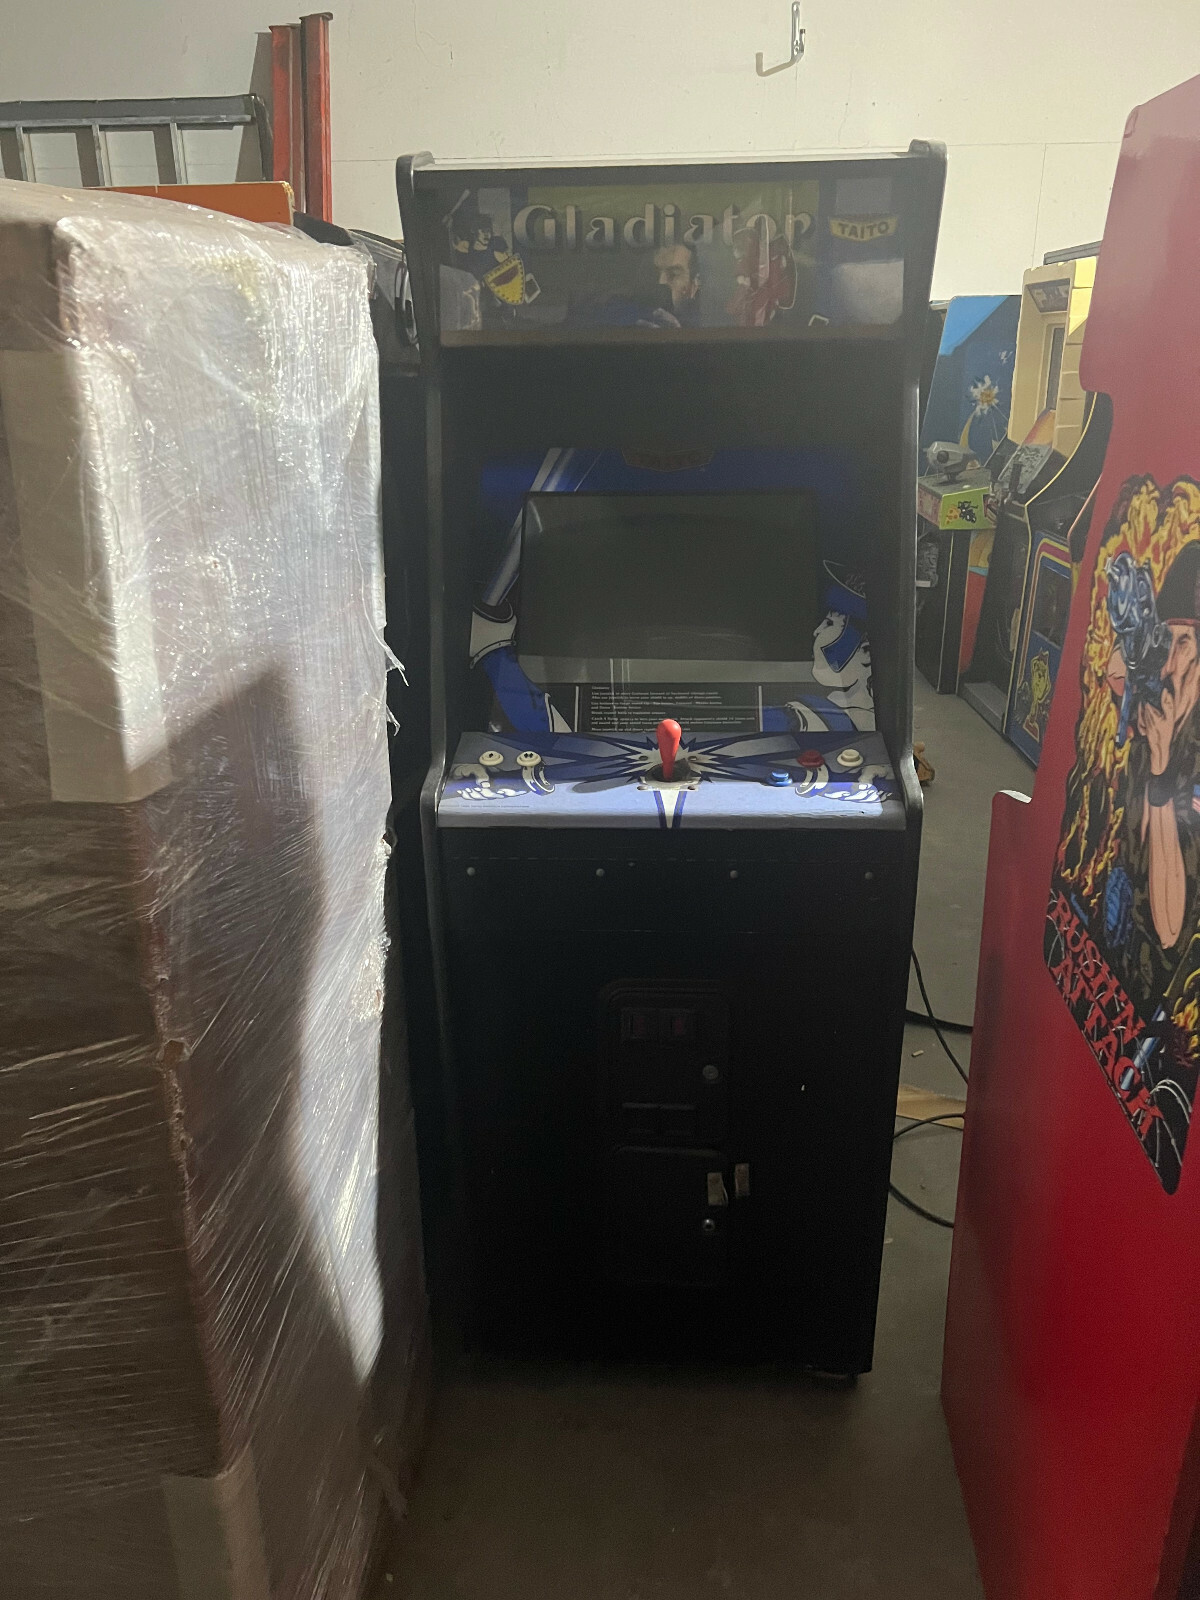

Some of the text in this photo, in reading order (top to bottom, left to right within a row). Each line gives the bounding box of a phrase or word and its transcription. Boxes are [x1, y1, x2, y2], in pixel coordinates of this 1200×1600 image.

[513, 203, 812, 249] Gladiator
[838, 222, 889, 239] TAITO
[1053, 956, 1164, 1141] ATTACK
